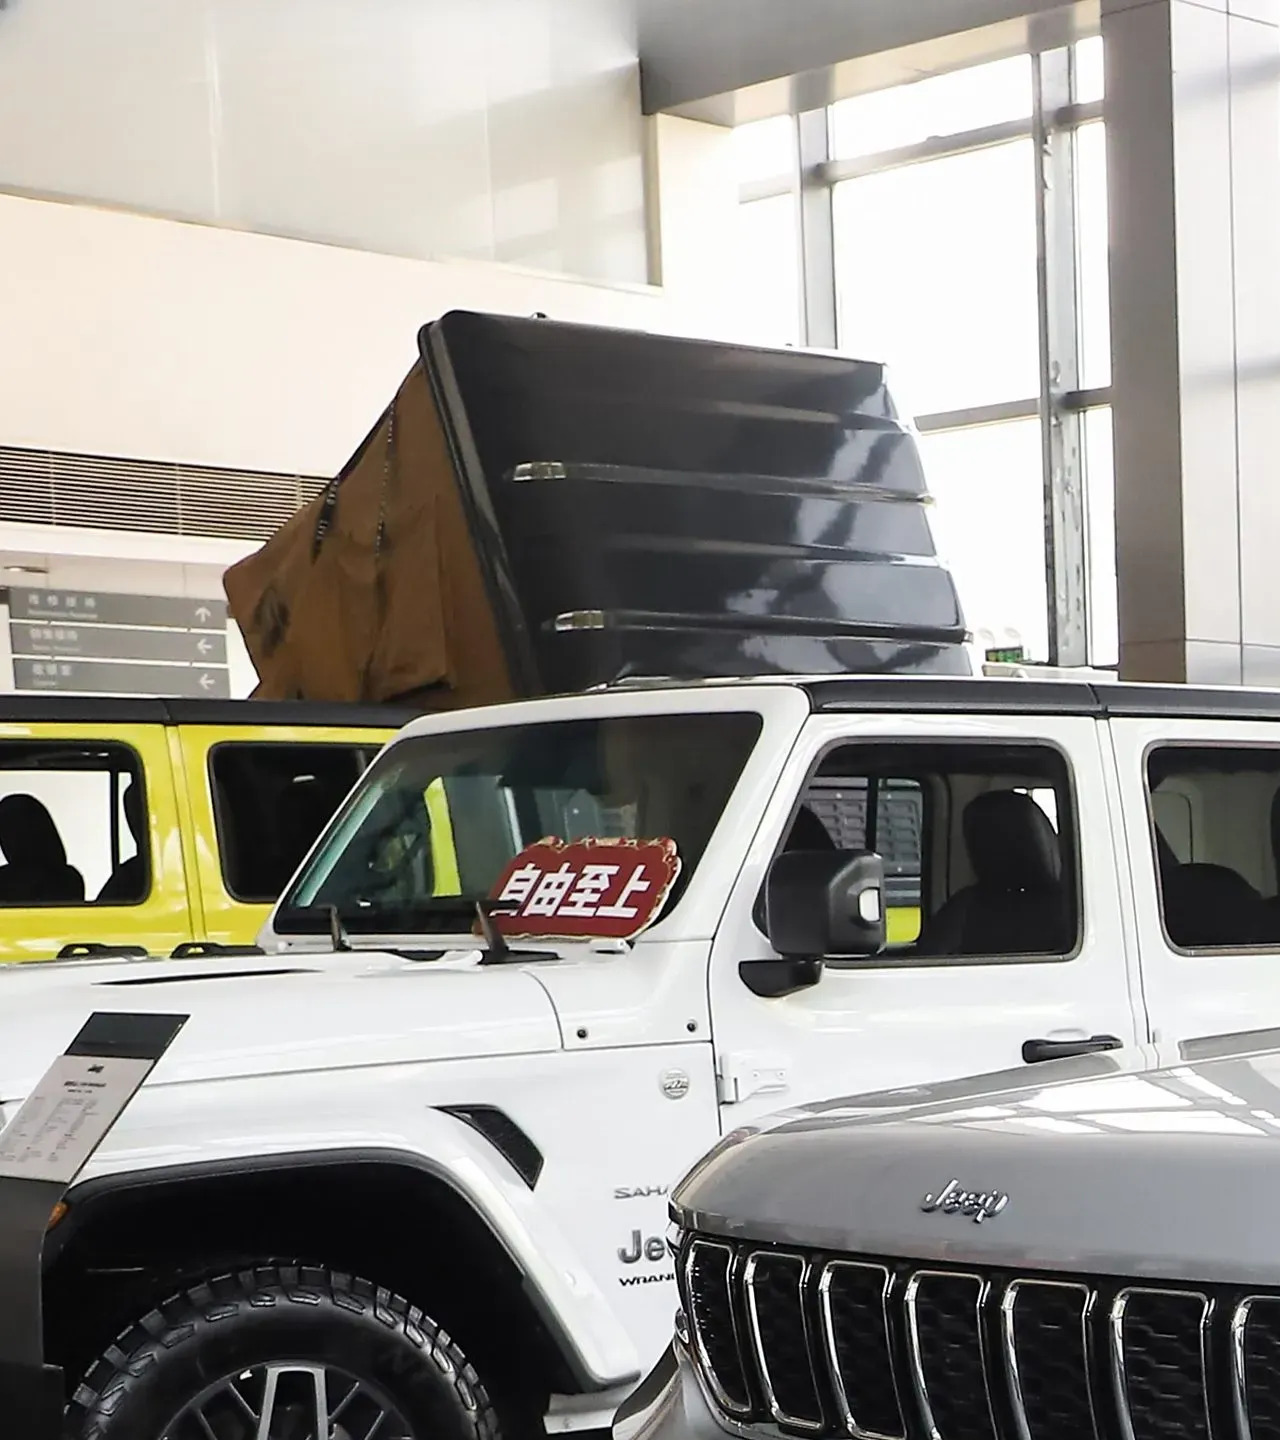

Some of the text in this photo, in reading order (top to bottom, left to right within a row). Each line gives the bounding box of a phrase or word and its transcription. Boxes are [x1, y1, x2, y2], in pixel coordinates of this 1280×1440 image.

[488, 862, 651, 919] 自由至上
[920, 1178, 1010, 1225] Jeep
